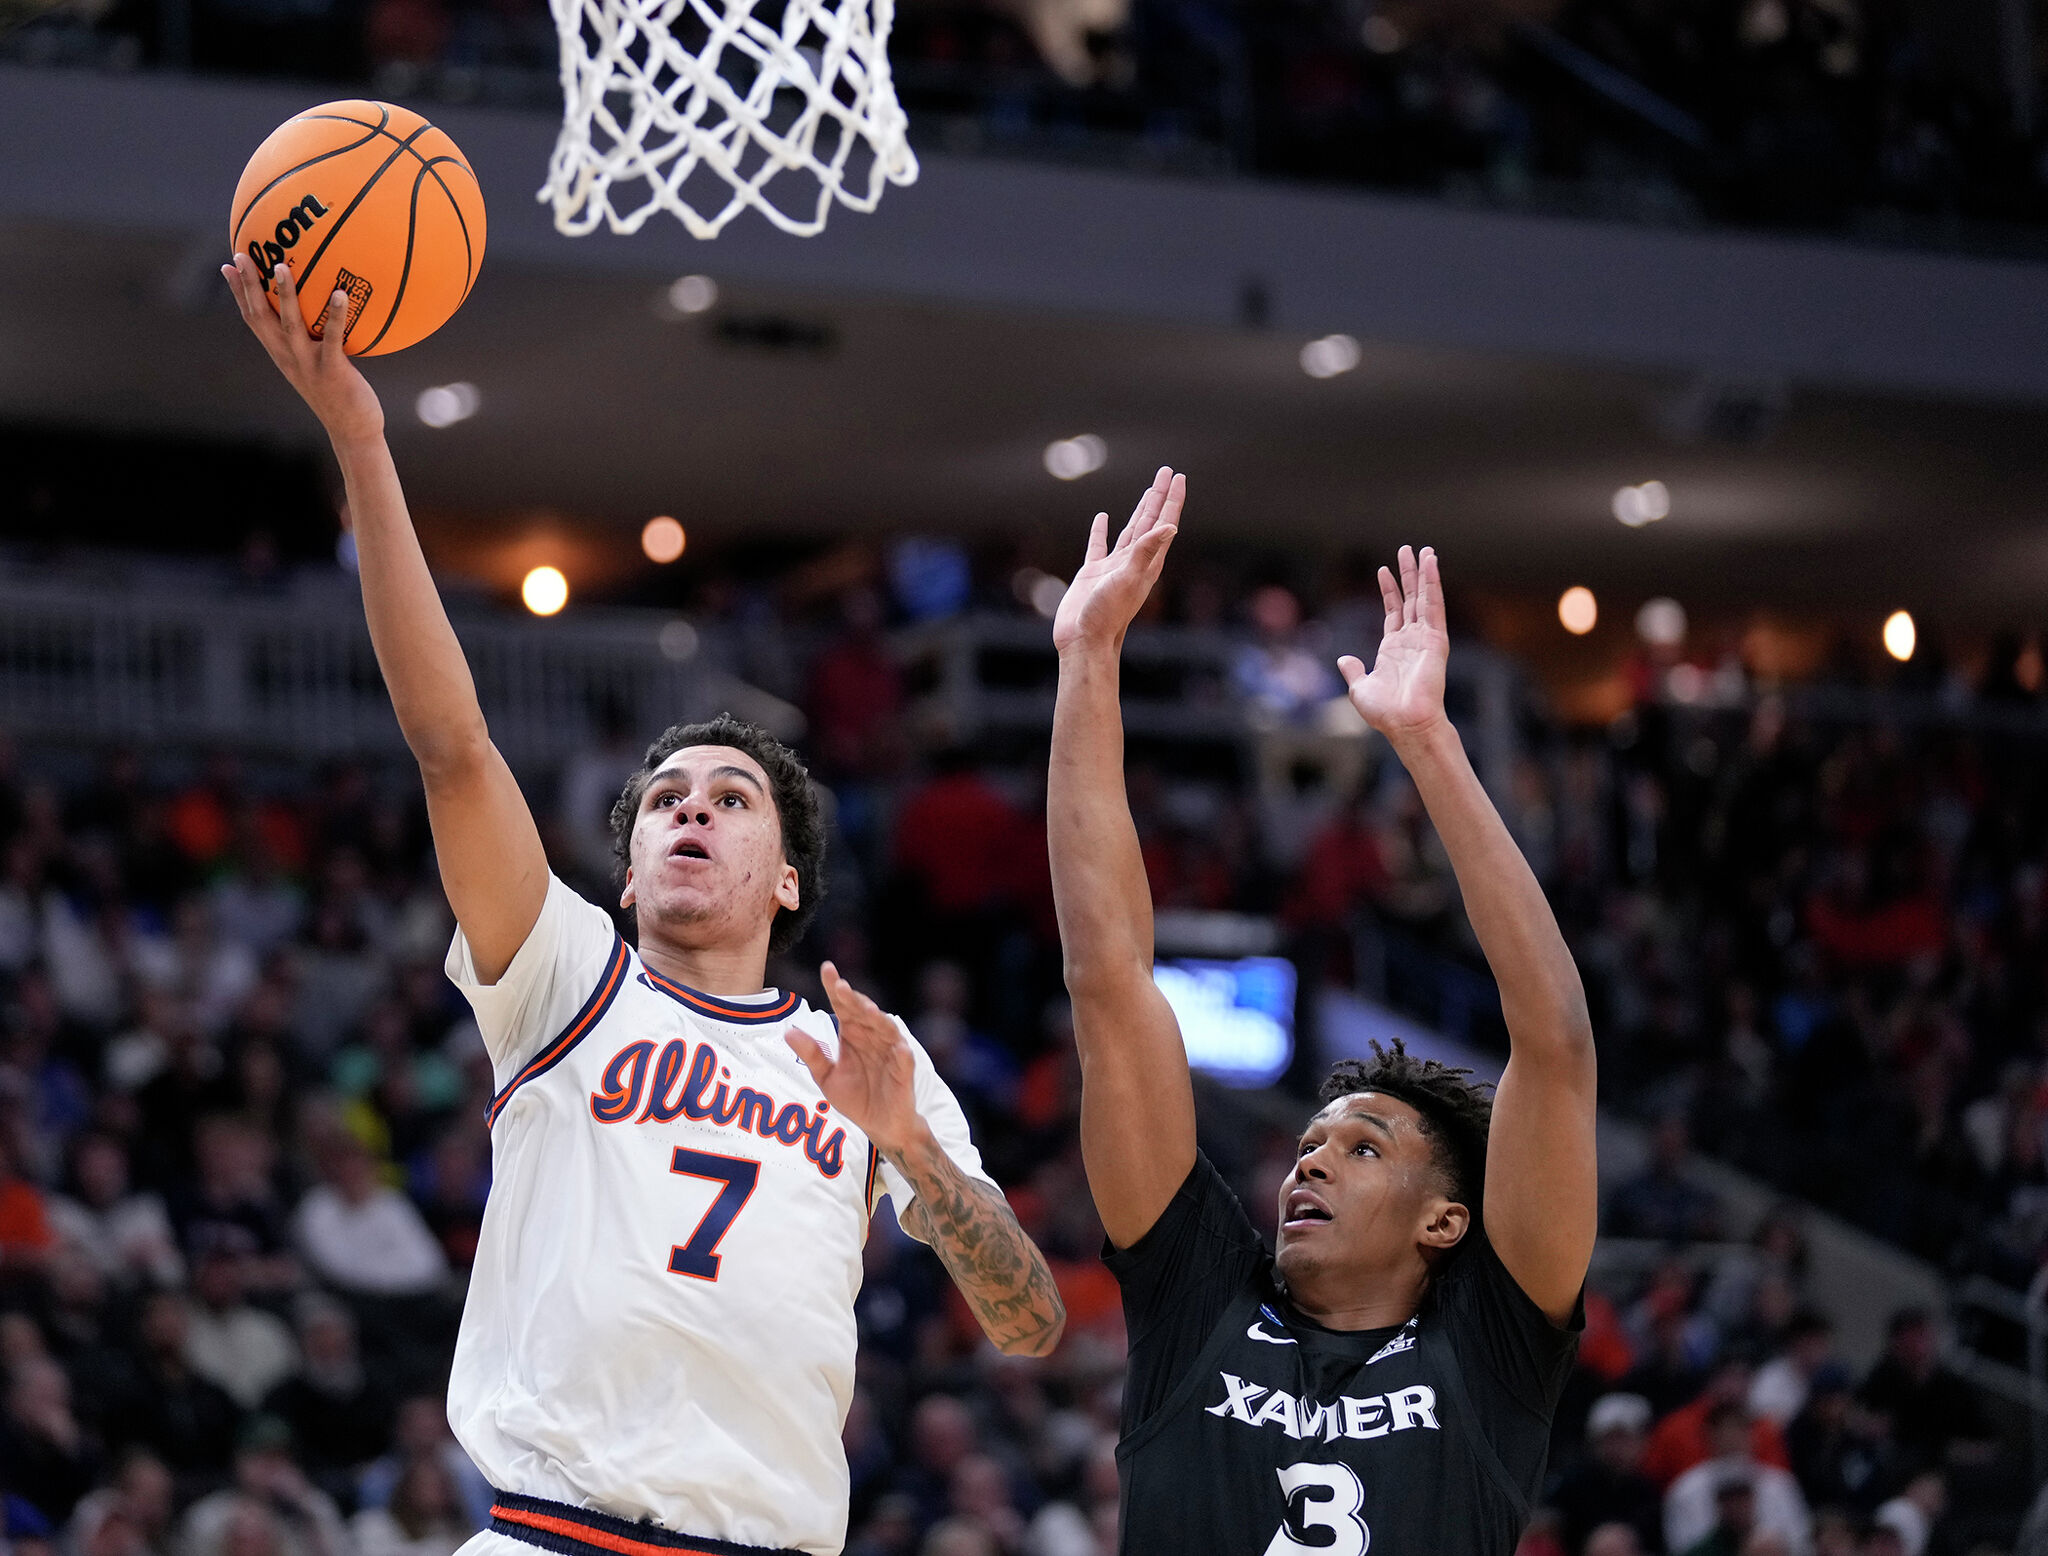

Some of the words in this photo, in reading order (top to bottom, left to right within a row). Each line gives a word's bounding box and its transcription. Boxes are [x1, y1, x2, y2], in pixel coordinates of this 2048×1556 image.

[248, 194, 329, 292] lson
[590, 1038, 847, 1179] Illinois
[666, 1145, 761, 1282] 7
[1204, 1371, 1442, 1444] XAVIER
[1262, 1460, 1371, 1556] 3
